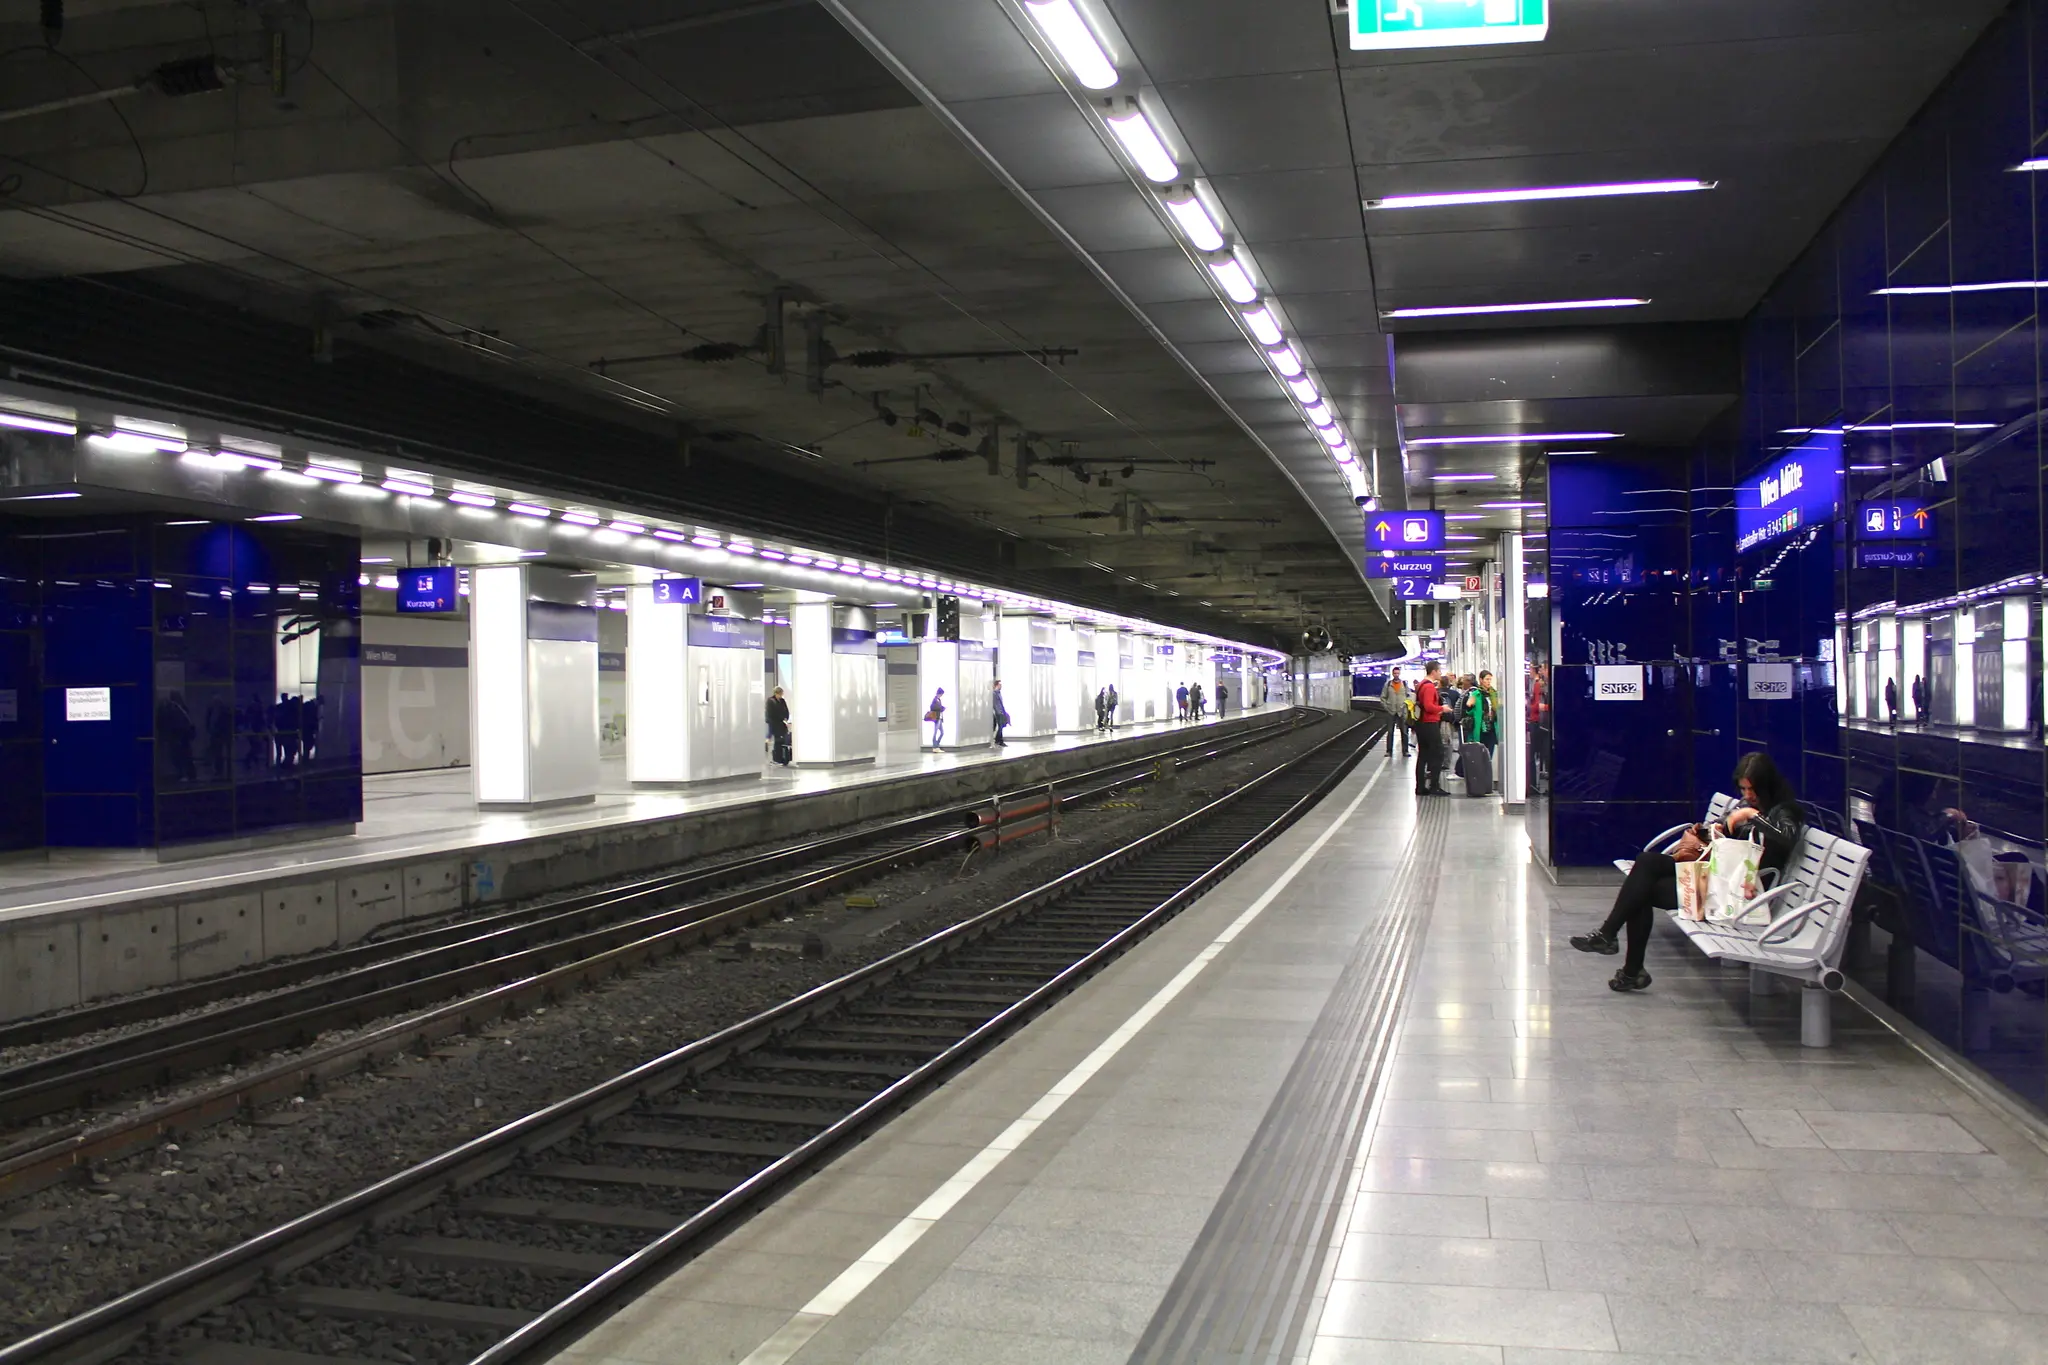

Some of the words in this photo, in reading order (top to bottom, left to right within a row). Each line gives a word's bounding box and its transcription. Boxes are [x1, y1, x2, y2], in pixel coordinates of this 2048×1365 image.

[1760, 477, 1779, 508] Wien
[1780, 462, 1803, 497] Mitte
[1393, 562, 1432, 572] Kurzzug
[659, 583, 670, 600] 3
[682, 587, 693, 599] A
[1403, 580, 1415, 595] 2
[406, 600, 435, 609] Kurzzug
[711, 621, 726, 633] Wien
[1602, 683, 1637, 694] SN132
